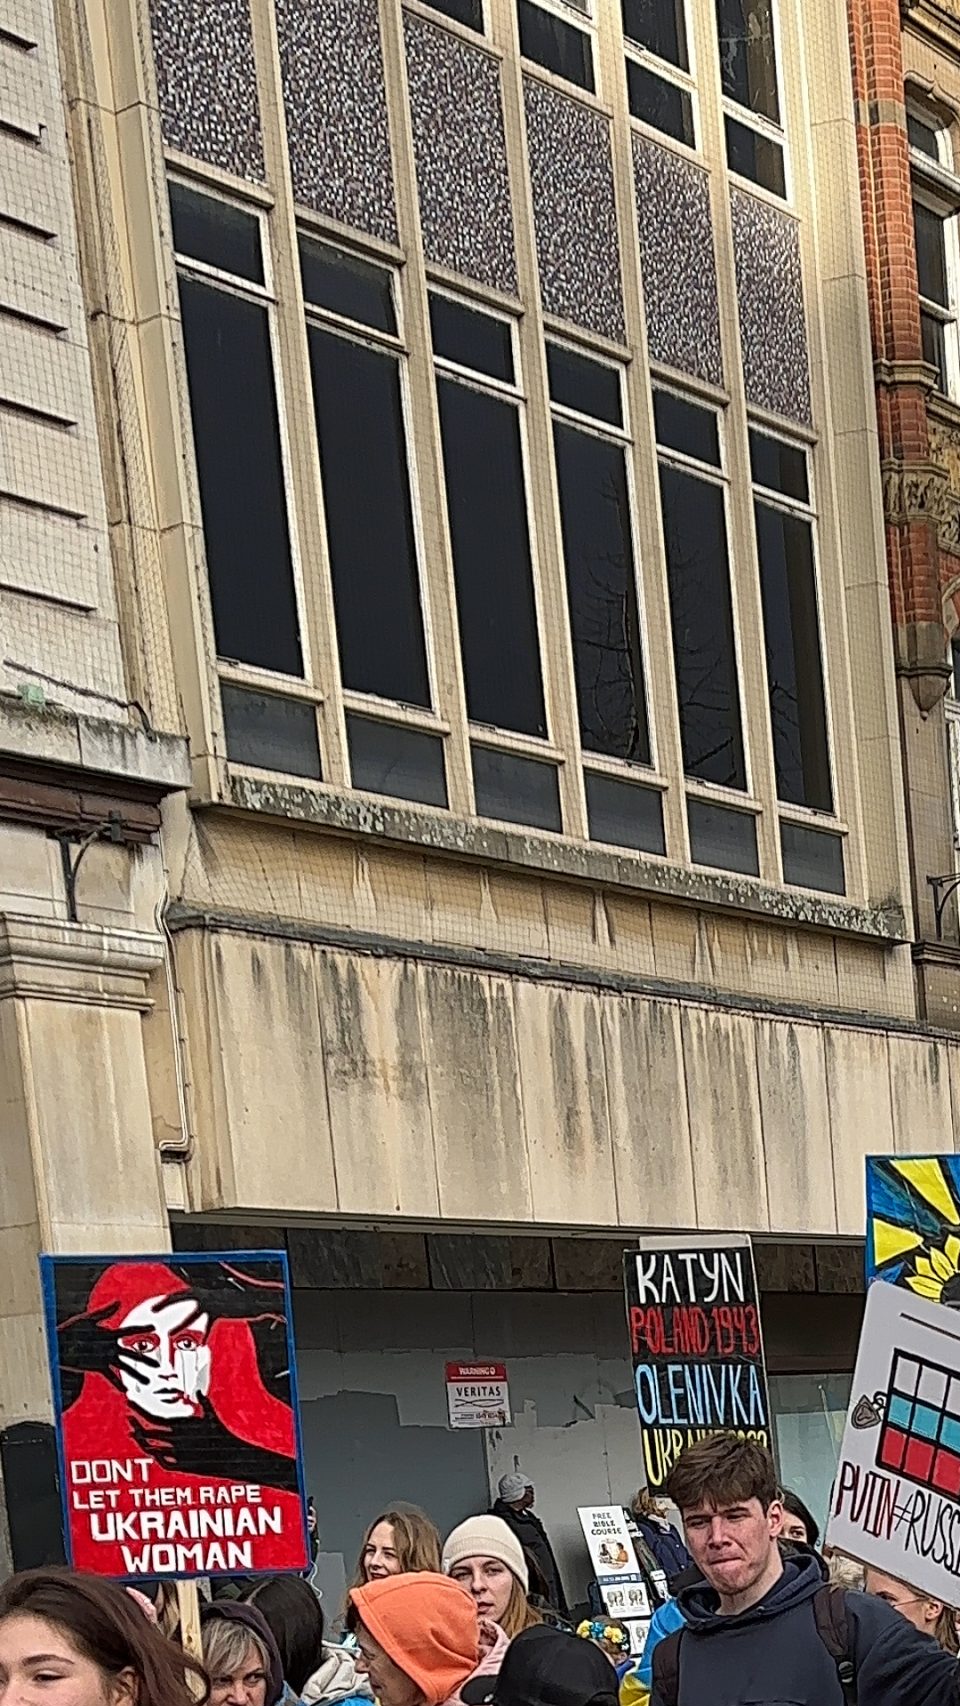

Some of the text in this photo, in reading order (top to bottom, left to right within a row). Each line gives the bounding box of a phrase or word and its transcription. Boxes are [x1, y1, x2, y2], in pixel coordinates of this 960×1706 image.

[635, 1252, 744, 1304] KATYN
[631, 1304, 761, 1356] POLAND 1943
[456, 1386, 501, 1397] VERITAS
[635, 1364, 766, 1425] OLENIVKA
[70, 1457, 154, 1485] DONT
[73, 1485, 262, 1510] LET THEM RAPE
[90, 1506, 282, 1542] UKRAINIAN
[591, 1528, 622, 1536] COURSE
[121, 1540, 254, 1573] WOMAN
